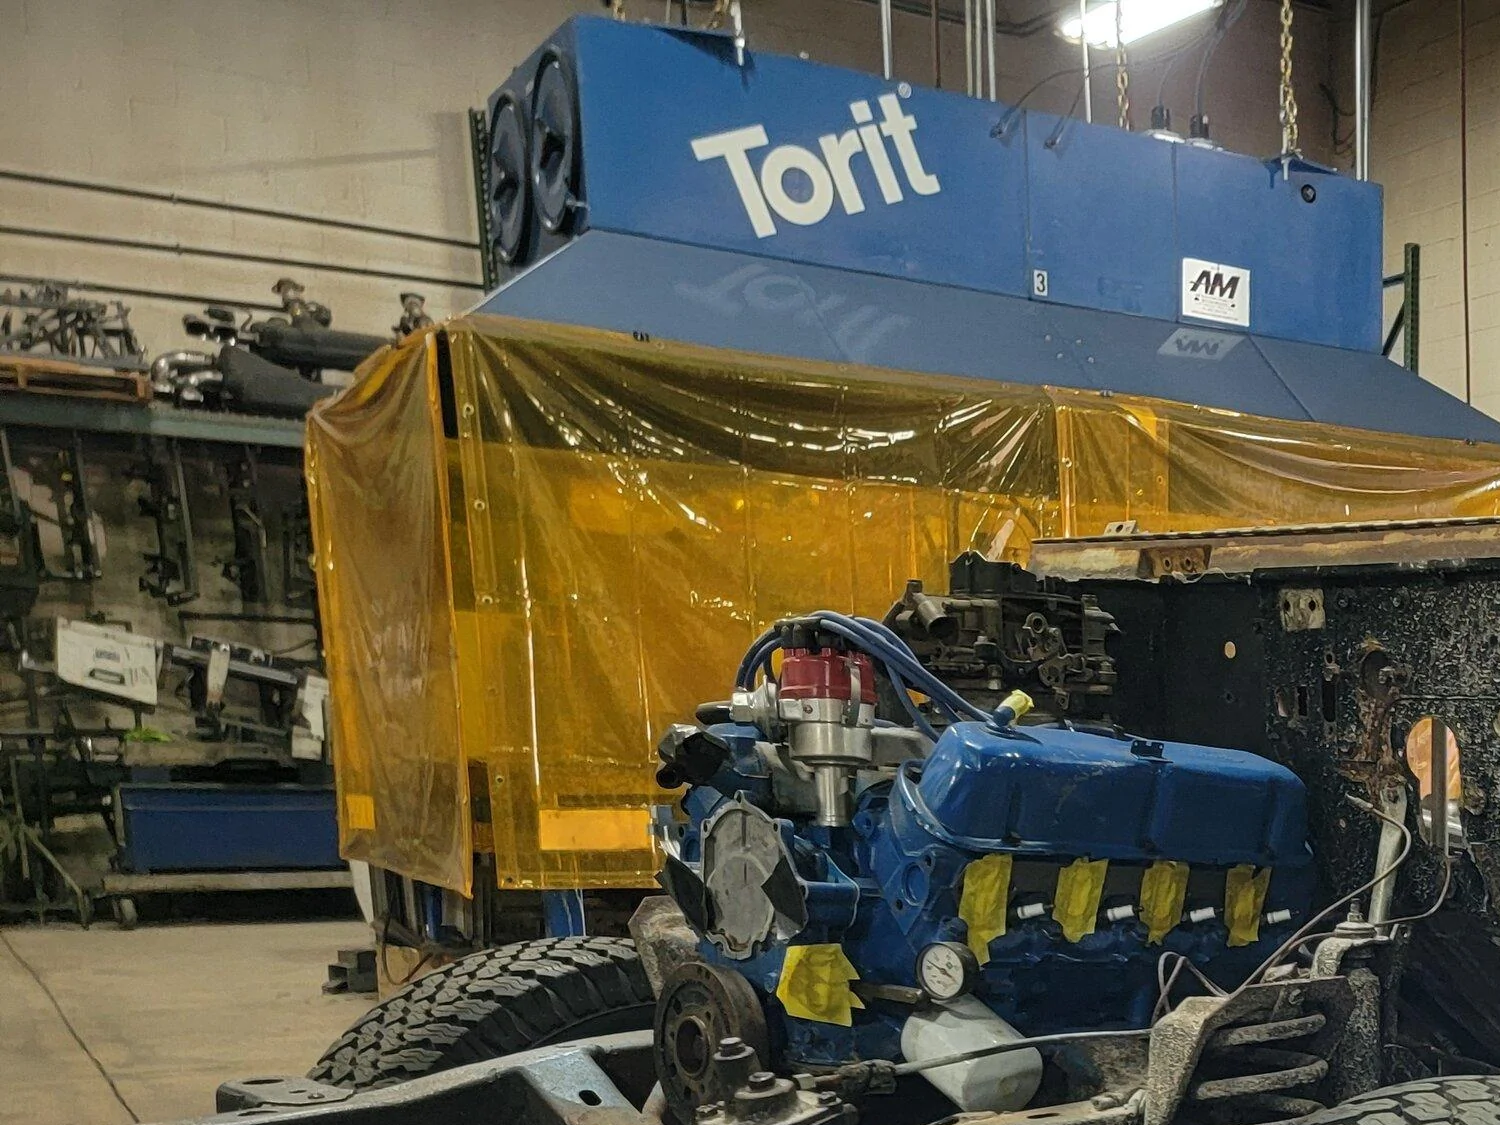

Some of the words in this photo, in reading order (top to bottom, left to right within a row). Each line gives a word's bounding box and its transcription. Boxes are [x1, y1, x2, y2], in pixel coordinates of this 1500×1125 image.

[691, 93, 941, 238] Torit
[1037, 273, 1045, 292] 3
[1189, 269, 1240, 299] AM
